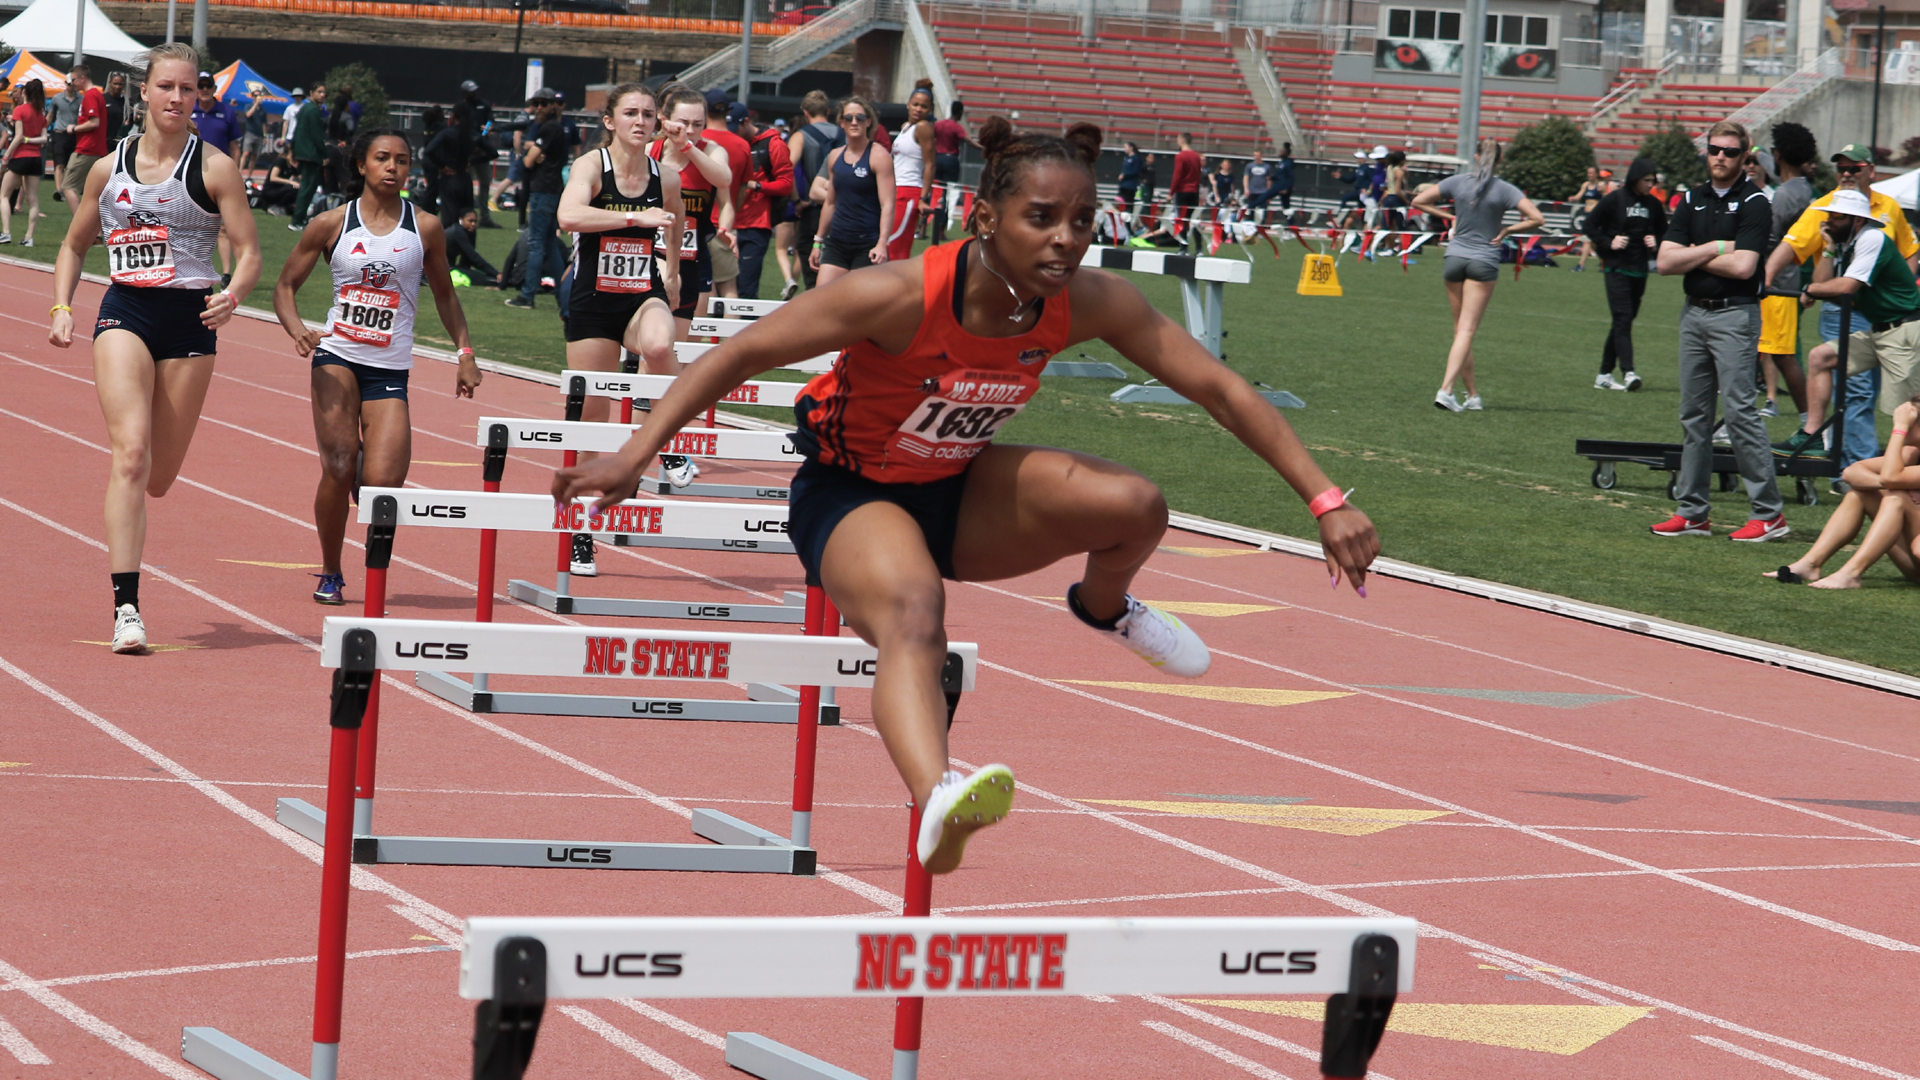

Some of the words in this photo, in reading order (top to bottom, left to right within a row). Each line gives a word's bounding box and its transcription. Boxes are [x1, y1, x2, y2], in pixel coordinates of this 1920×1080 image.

[128, 230, 158, 242] STATE
[604, 242, 619, 252] NC
[620, 243, 644, 253] STATE
[113, 243, 166, 271] 1607
[602, 255, 649, 277] 1817
[136, 270, 171, 280] adidas
[619, 280, 648, 289] adidas
[345, 289, 361, 301] NC
[361, 292, 391, 307] STATE
[730, 304, 754, 312] UCS
[341, 302, 393, 331] 1608
[690, 324, 717, 332] UCS
[356, 330, 388, 342] adidas
[595, 381, 632, 392] UCS
[722, 384, 759, 403] ATE
[946, 381, 976, 401] NC
[972, 383, 1026, 403] STATE
[914, 401, 1016, 439] 1692
[520, 430, 563, 443] UCS
[756, 489, 788, 498] UCS
[411, 504, 467, 519] UCS
[552, 502, 585, 531] NC
[588, 504, 664, 534] STATE
[722, 539, 758, 549] UCS
[688, 606, 730, 617] UCS
[395, 641, 470, 660] UCS
[583, 635, 627, 676] NC
[630, 637, 732, 680] STATE
[837, 659, 878, 676] UC
[632, 701, 684, 715] UCS
[546, 847, 612, 864] UCS
[575, 952, 684, 979] UCS
[853, 932, 916, 991] NC
[922, 932, 1067, 991] STATE
[1220, 951, 1318, 975] UCS
